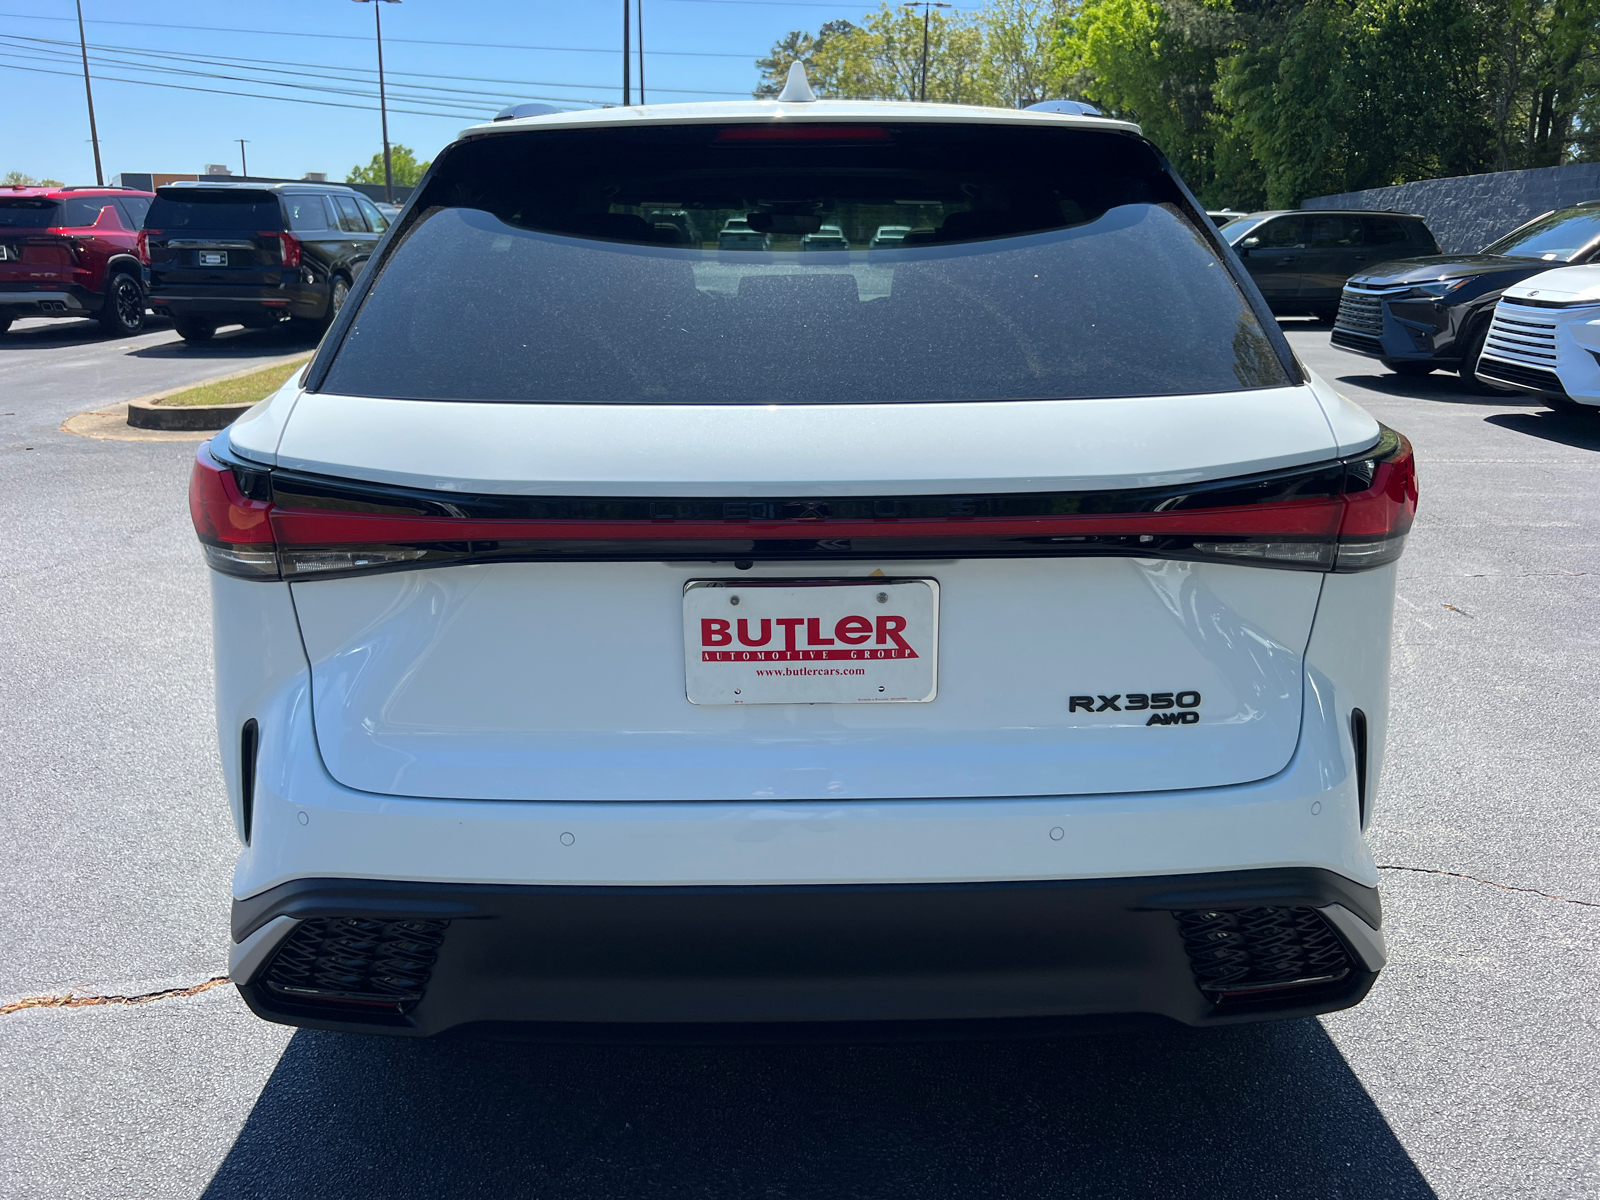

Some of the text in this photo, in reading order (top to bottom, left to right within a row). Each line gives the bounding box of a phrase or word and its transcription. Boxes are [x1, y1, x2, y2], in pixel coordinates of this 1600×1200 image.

[650, 499, 975, 519] LEXUS
[703, 648, 911, 661] AUTOMOTIVE GROUP
[756, 667, 865, 677] www.butlercars.com
[1146, 711, 1199, 726] AWD
